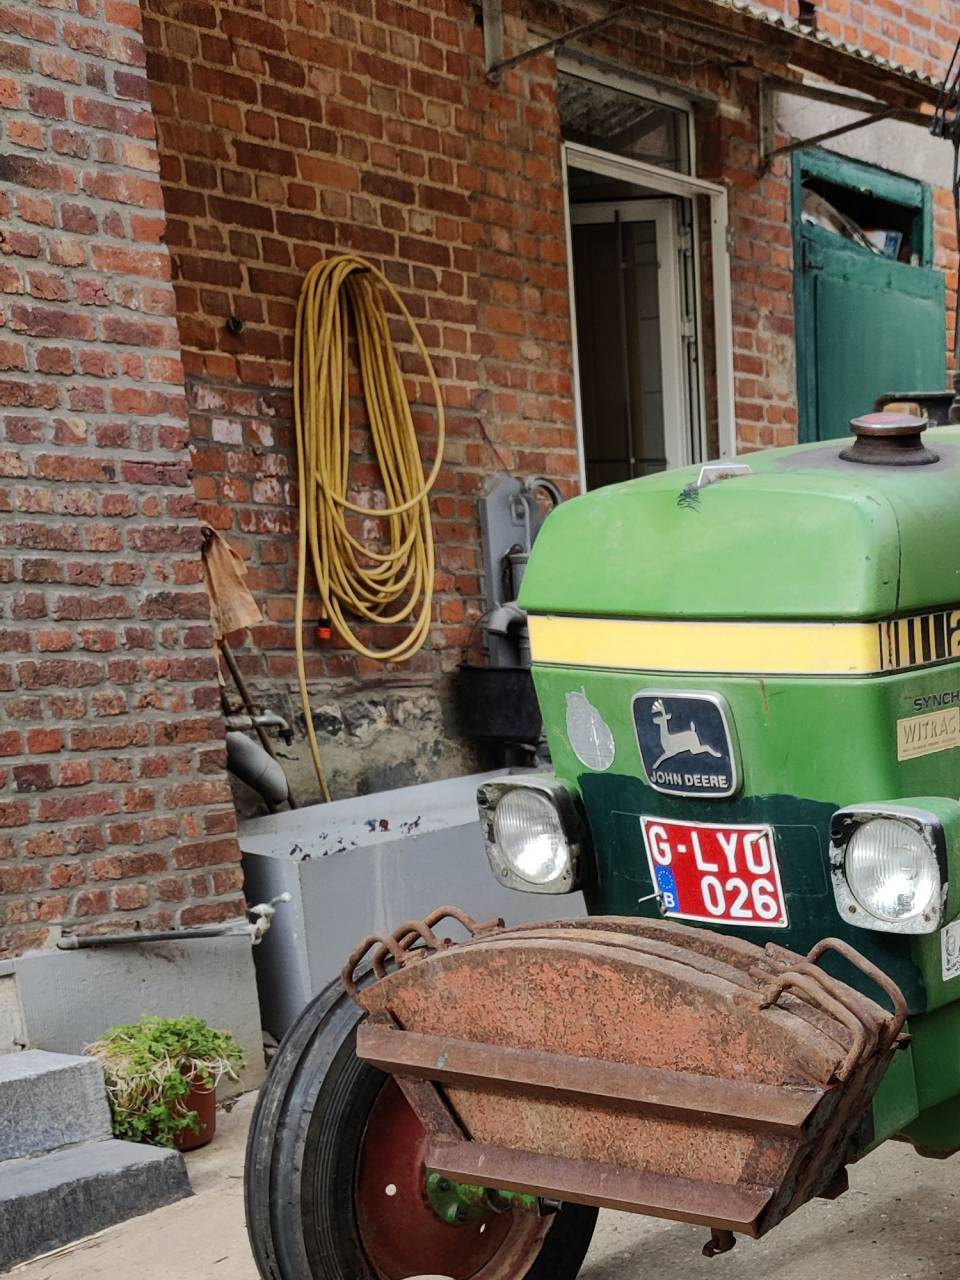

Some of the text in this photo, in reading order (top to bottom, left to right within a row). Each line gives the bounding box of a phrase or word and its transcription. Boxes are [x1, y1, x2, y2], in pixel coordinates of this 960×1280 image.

[651, 771, 729, 788] JOHN DEERE
[663, 892, 675, 907] B
[701, 875, 778, 919] 026
